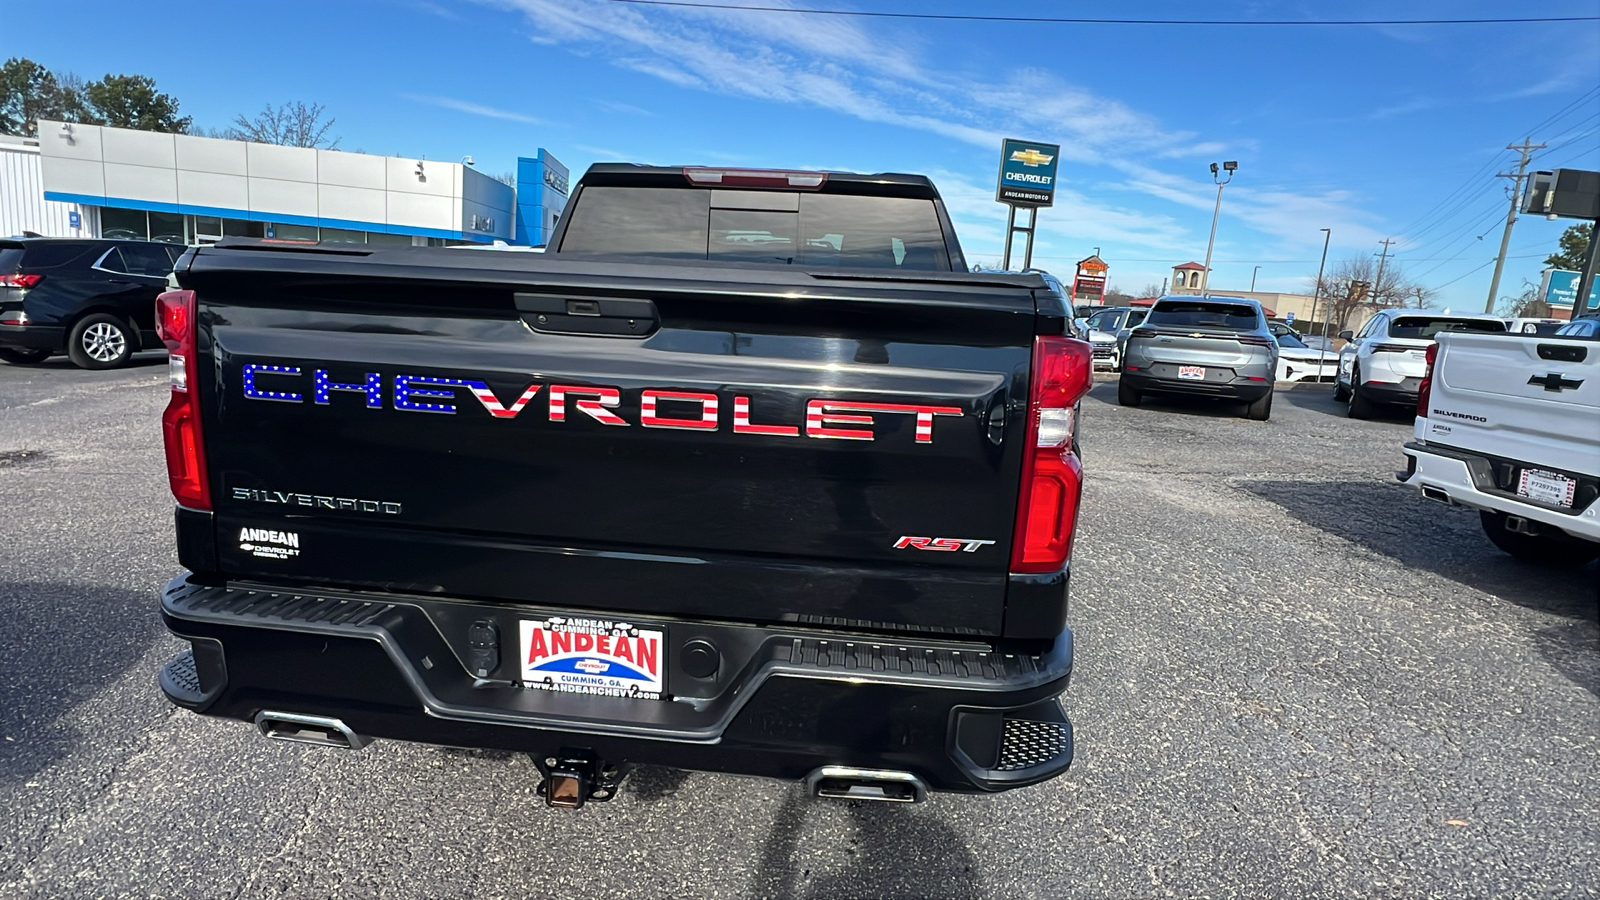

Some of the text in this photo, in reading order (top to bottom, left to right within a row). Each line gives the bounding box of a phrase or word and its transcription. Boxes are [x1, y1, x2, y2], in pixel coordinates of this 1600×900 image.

[1006, 172, 1052, 184] CHEVROLET
[243, 364, 964, 443] CHEVROLET
[1433, 409, 1487, 422] SILVERADO
[232, 487, 402, 514] SILVERADO
[240, 527, 299, 548] ANDEAN
[892, 536, 996, 552] RST
[255, 546, 300, 556] CHEVROLET
[551, 624, 629, 637] CUMMING, GA
[567, 618, 613, 629] ANDEAN
[528, 628, 658, 677] ANDEAN
[561, 675, 625, 687] CUMMING, GA.
[523, 681, 660, 700] www.ANDEANCHEVY.com
